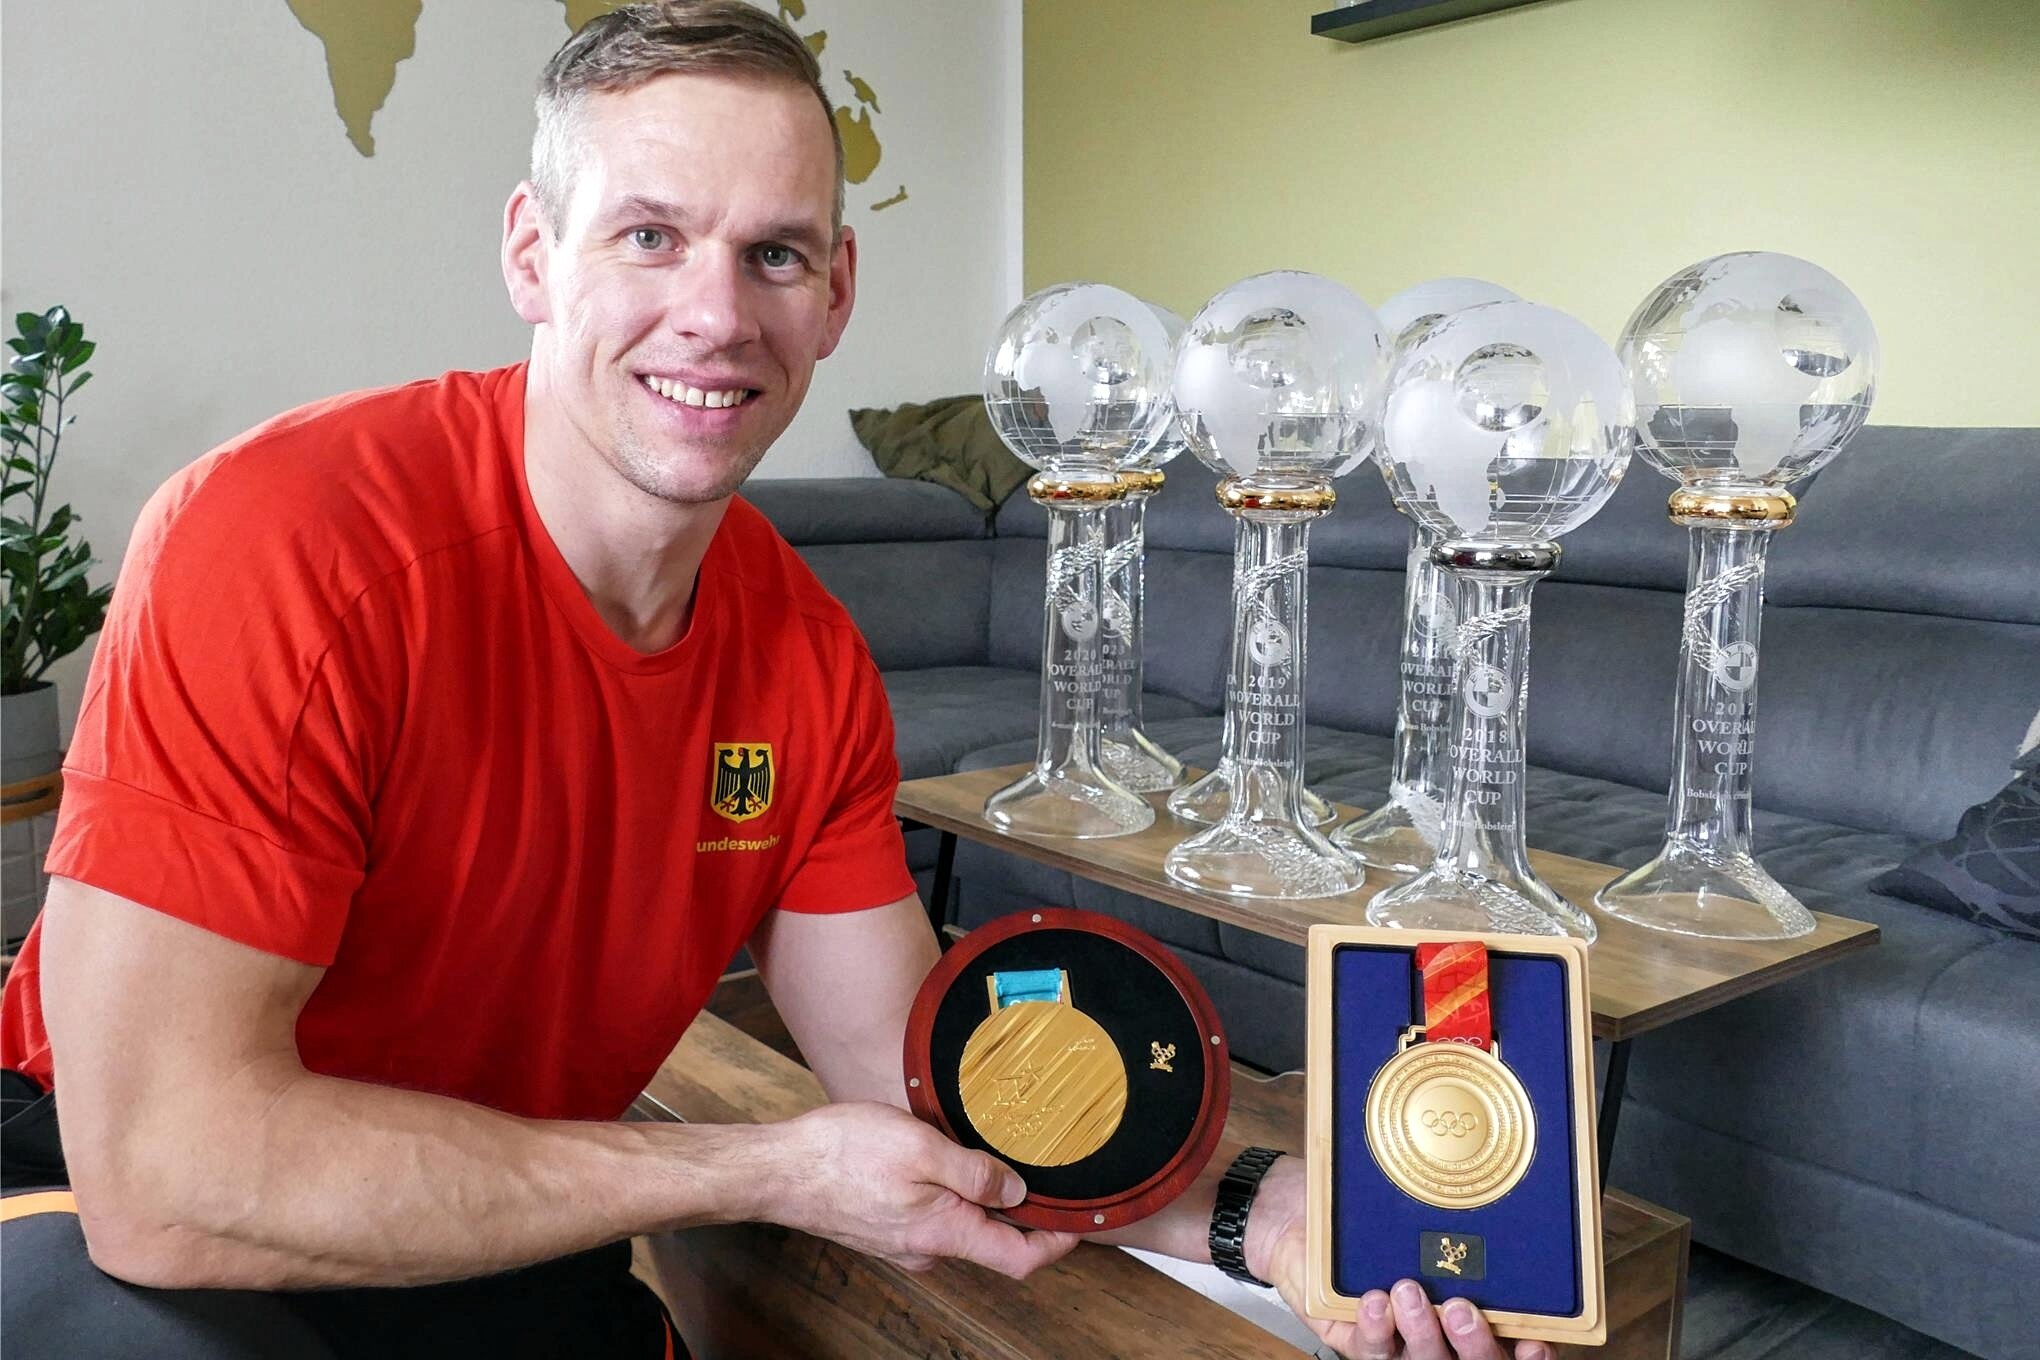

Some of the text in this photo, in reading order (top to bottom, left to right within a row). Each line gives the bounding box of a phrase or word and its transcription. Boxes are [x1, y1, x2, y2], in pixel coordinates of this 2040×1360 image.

[1064, 649, 1097, 661] 2020
[1053, 680, 1101, 693] WORLD
[1249, 674, 1286, 689] 2019
[1066, 698, 1094, 710] CUP
[1237, 690, 1300, 707] OVERALL
[1412, 698, 1443, 713] CUP
[1239, 709, 1295, 726] WORLD
[1249, 730, 1281, 745] CUP
[1464, 727, 1507, 744] 2018
[1450, 744, 1522, 764] OVERALL
[1452, 766, 1516, 785] WORLD
[1714, 761, 1747, 776] CUP
[1464, 789, 1501, 806] CUP
[696, 834, 781, 853] undeswehr
